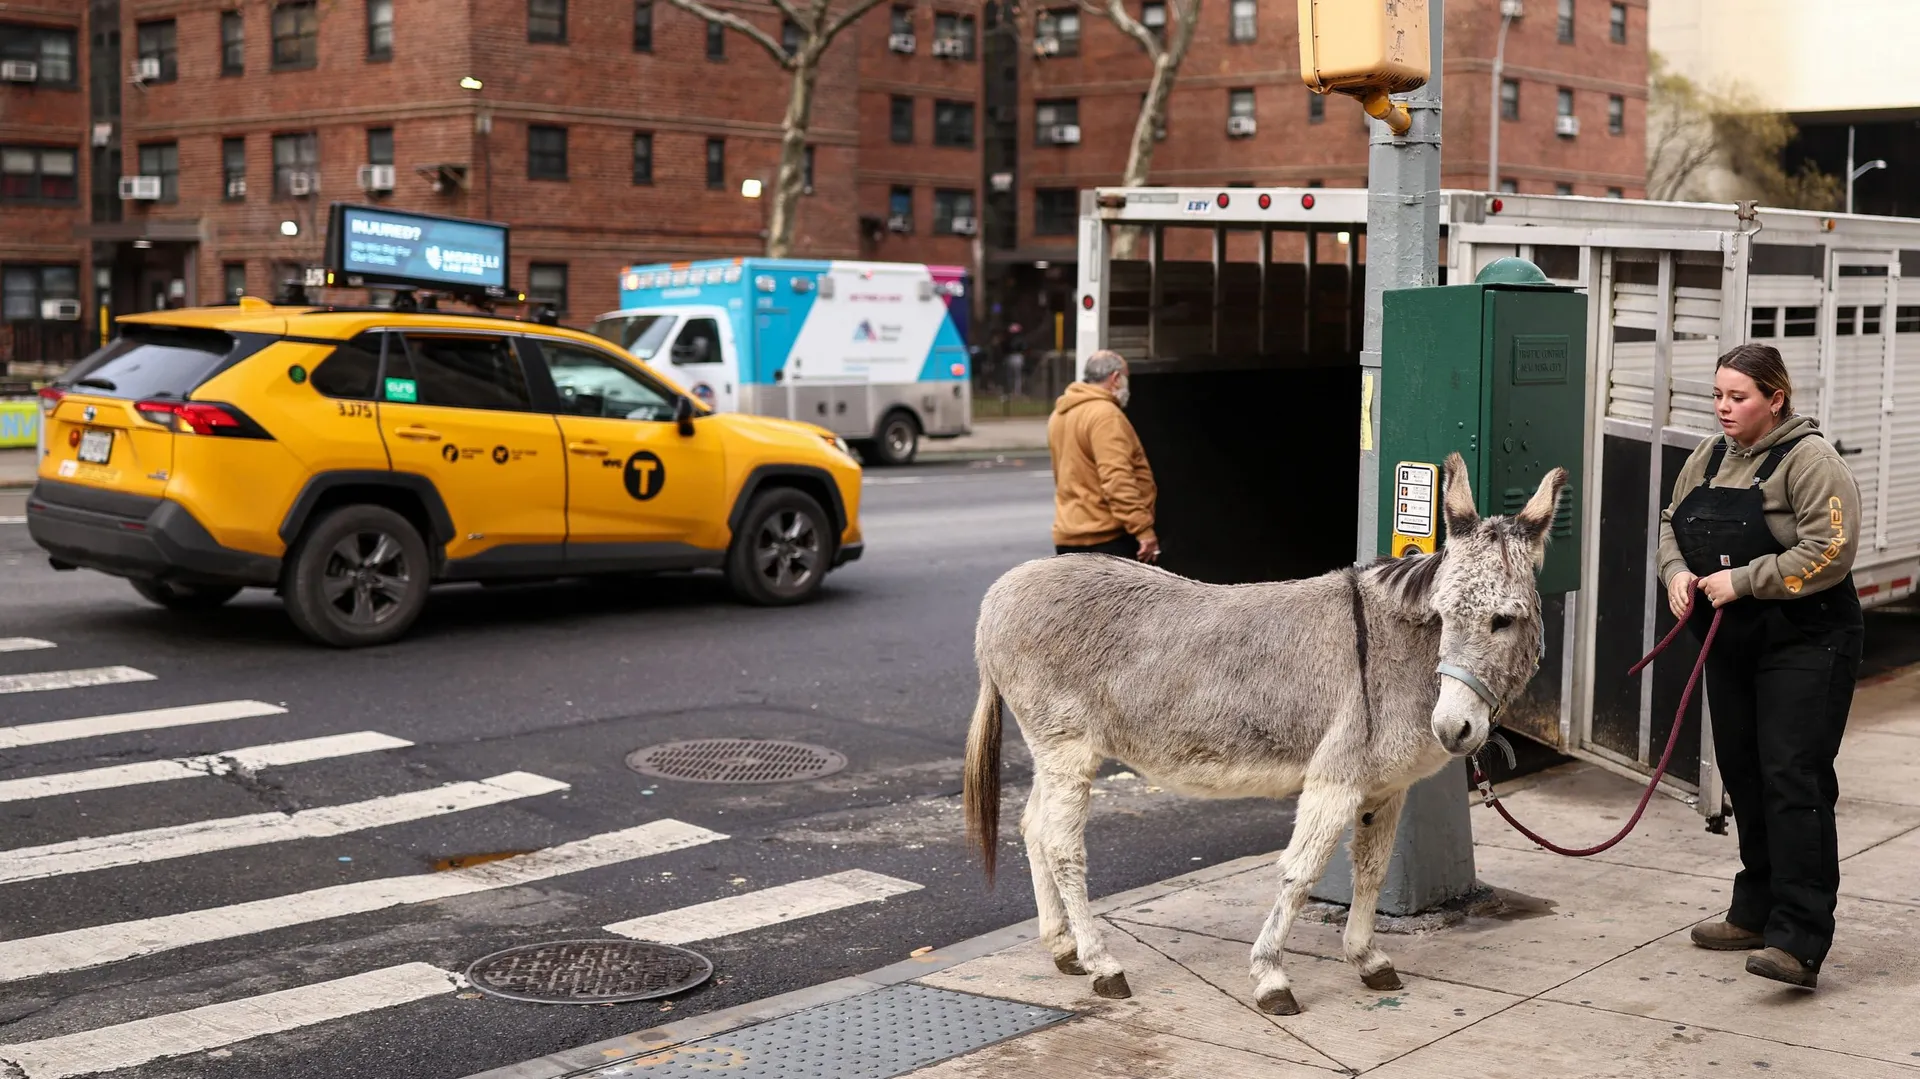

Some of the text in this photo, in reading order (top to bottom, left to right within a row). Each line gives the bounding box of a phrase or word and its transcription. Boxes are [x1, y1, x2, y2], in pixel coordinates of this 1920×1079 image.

[1187, 200, 1210, 211] EBY
[352, 219, 421, 241] INJURED?
[602, 458, 657, 496] NYC T
[1801, 495, 1847, 580] carhartt
